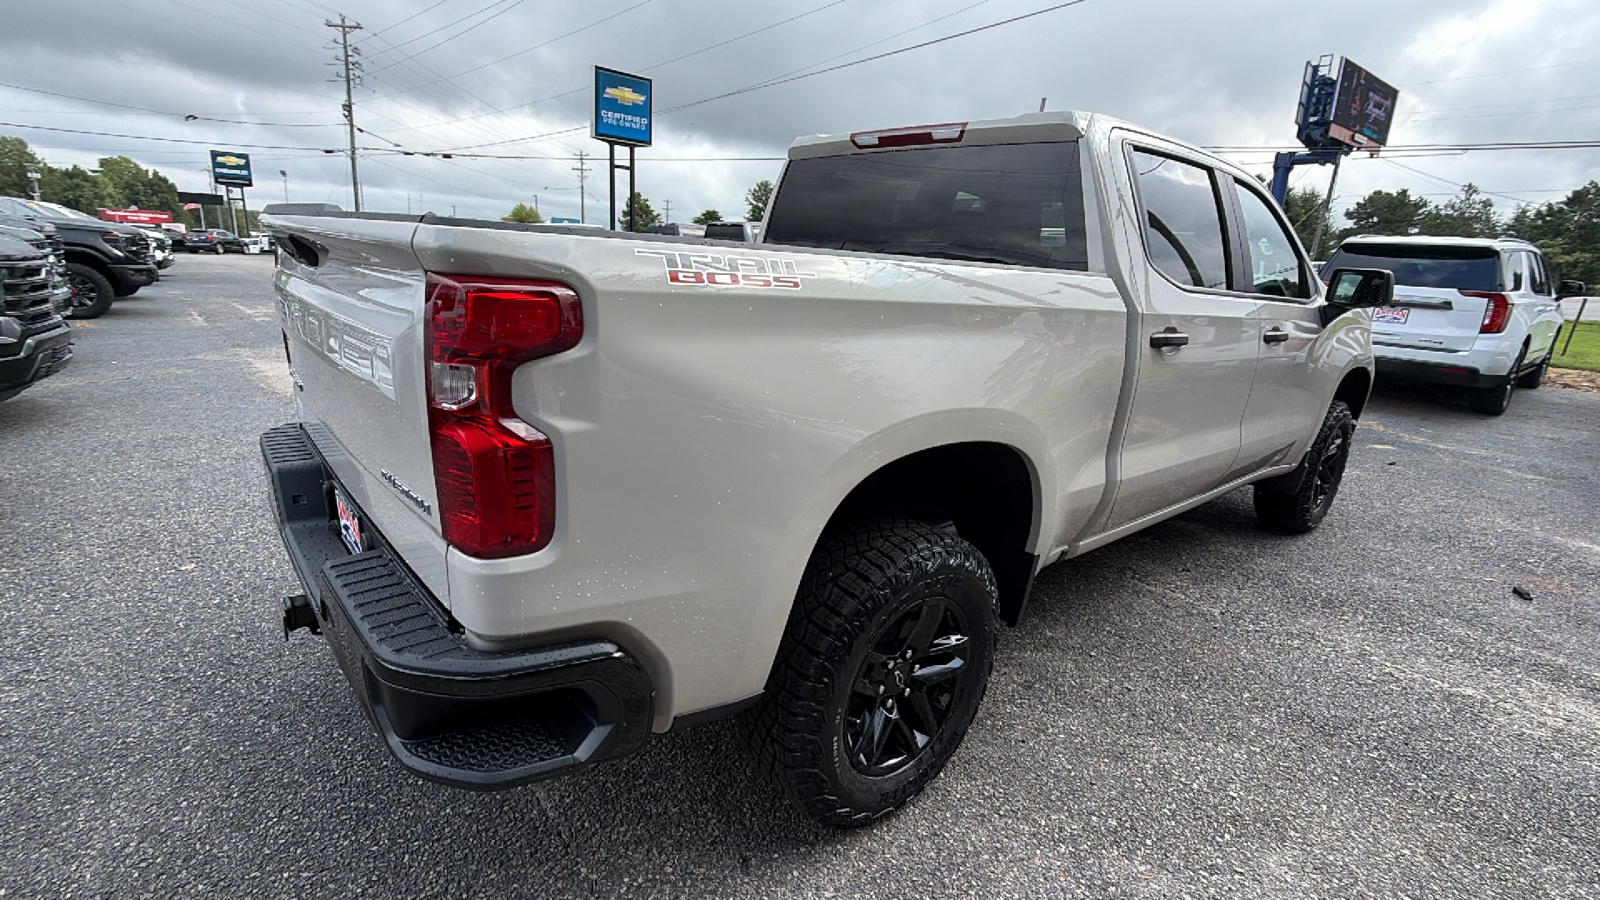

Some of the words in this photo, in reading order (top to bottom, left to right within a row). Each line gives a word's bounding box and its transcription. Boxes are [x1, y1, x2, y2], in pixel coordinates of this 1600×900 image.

[601, 109, 648, 125] CERTIFIED
[603, 117, 647, 131] PRE-OWNED
[633, 248, 818, 279] TRAIL
[667, 268, 803, 290] BOSS
